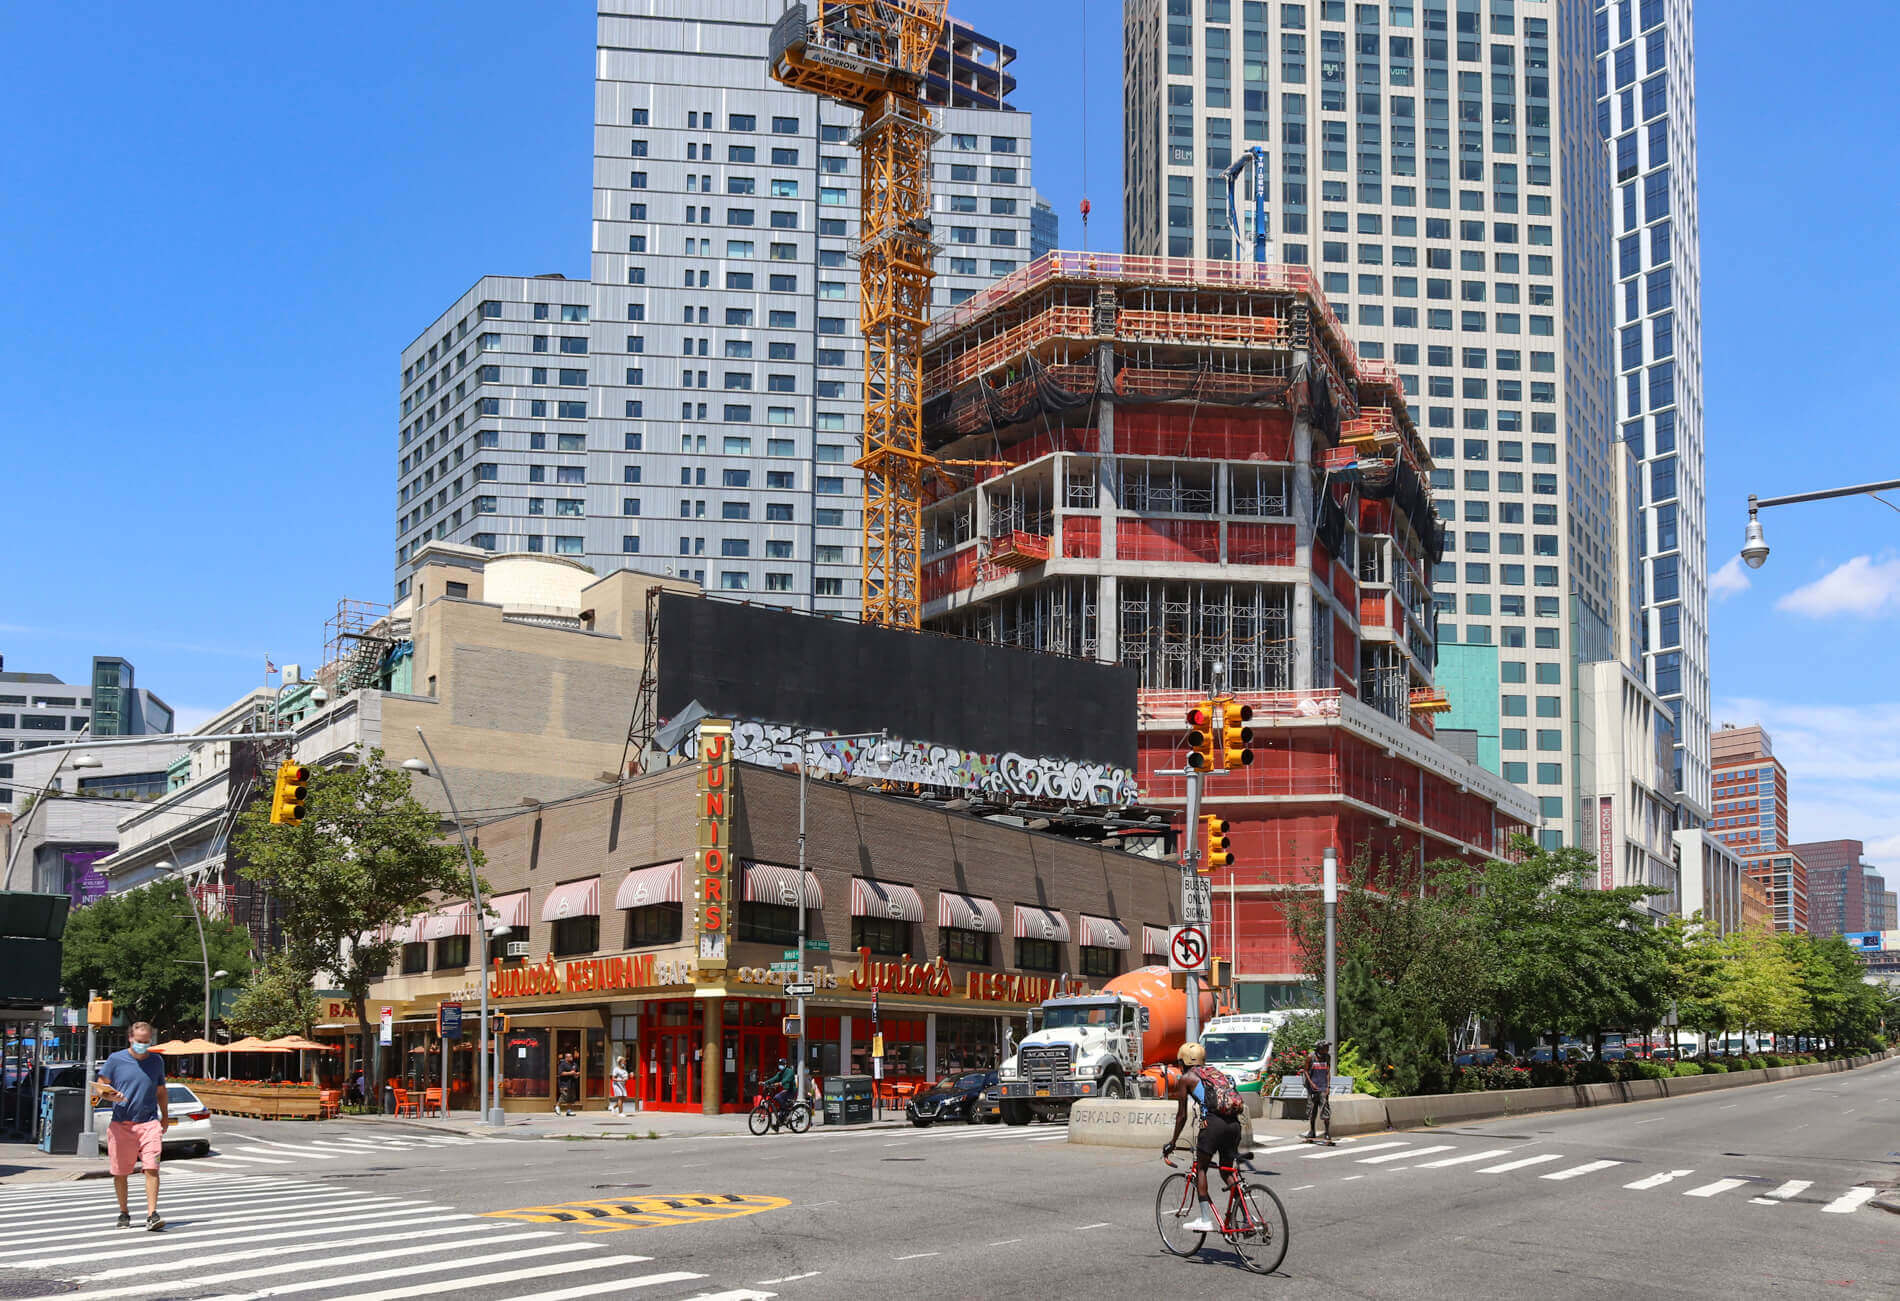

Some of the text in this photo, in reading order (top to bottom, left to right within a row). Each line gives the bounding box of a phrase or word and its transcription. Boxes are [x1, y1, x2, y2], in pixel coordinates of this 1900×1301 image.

[822, 56, 858, 71] MORROW
[1175, 149, 1193, 161] BLM
[704, 736, 725, 930] JUNIORS
[1184, 879, 1209, 892] BUSES
[1187, 893, 1207, 905] ONLY
[1185, 907, 1209, 919] SIGNAL
[490, 952, 560, 998] Junior's
[566, 954, 655, 992] RESTAURANT
[658, 960, 689, 986] BAR
[850, 946, 953, 997] Junior's
[329, 1003, 360, 1018] BA
[1075, 1110, 1120, 1124] DEKALB
